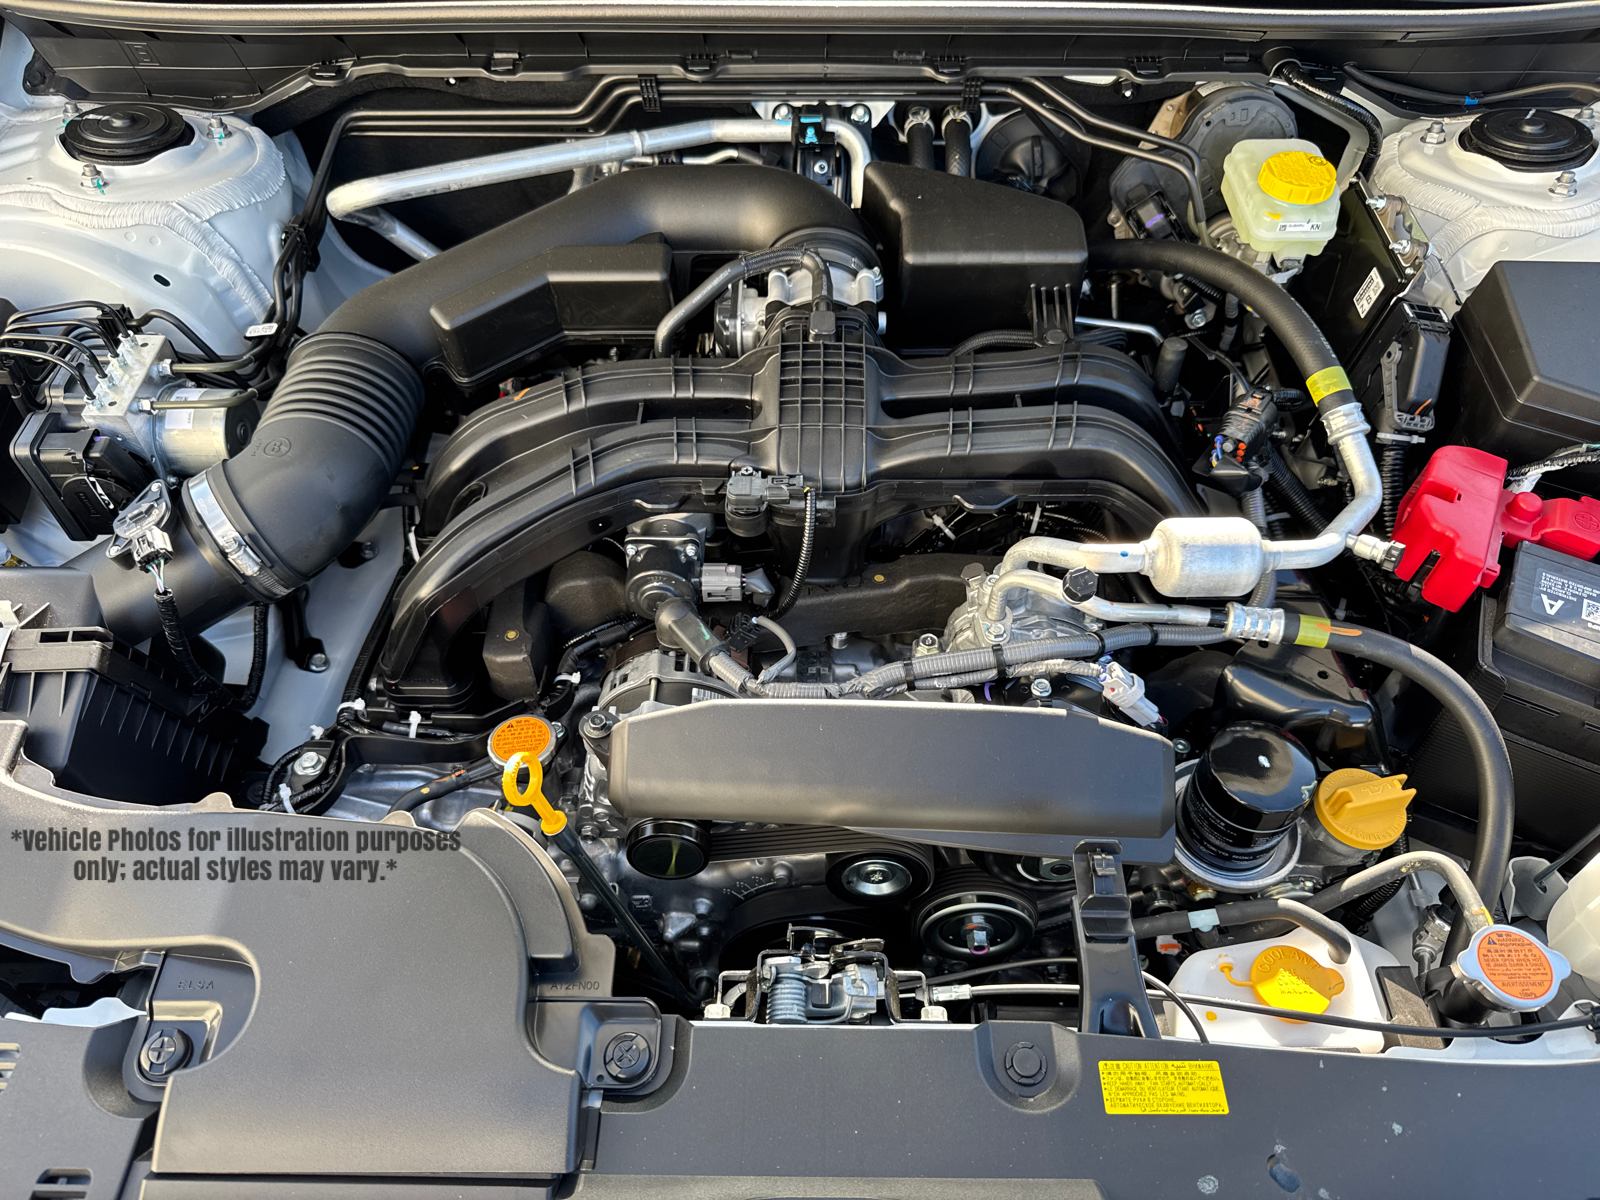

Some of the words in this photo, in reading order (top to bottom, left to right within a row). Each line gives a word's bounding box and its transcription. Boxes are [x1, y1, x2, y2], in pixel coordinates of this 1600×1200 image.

[1310, 223, 1321, 231] KN
[1323, 770, 1355, 792] ENGINE
[1342, 825, 1357, 837] SEE
[1203, 841, 1229, 857] TOKYO
[1257, 948, 1320, 972] COOLANT
[177, 980, 214, 990] ELSA
